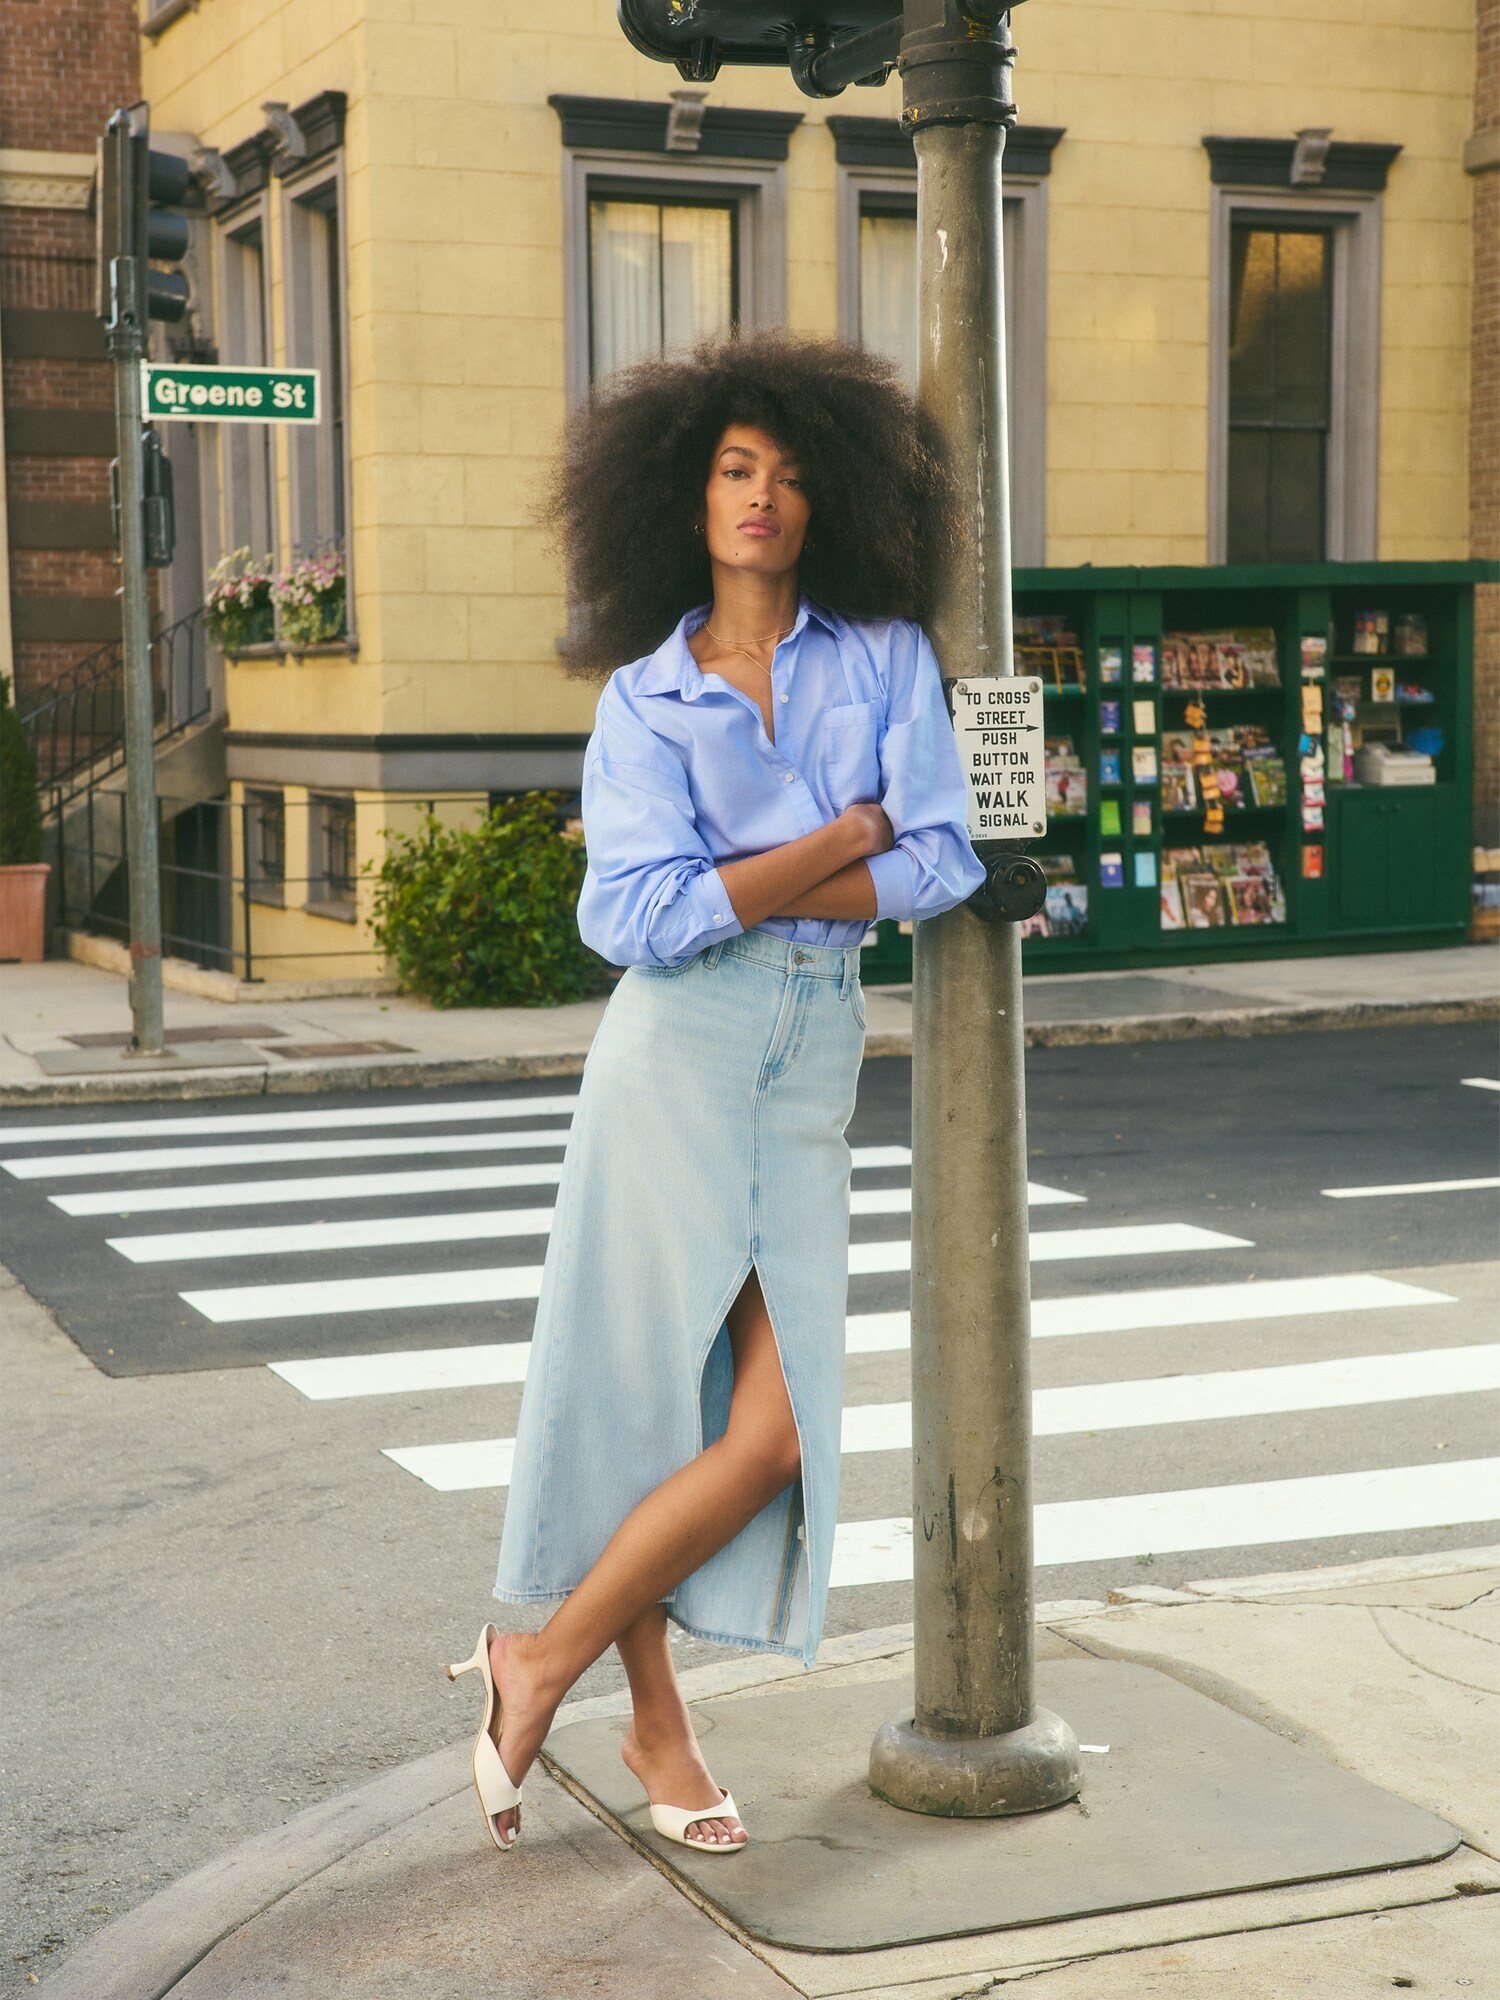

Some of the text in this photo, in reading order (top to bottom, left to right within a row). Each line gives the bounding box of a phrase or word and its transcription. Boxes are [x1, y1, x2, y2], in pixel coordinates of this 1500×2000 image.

[272, 381, 307, 409] St
[964, 691, 1031, 706] TO CROSS
[976, 710, 1026, 726] STREET
[982, 731, 1017, 746] PUSH
[972, 751, 1029, 767] BUTTON
[969, 771, 1035, 786] WAIT FOR
[975, 790, 1029, 809] WALK
[979, 812, 1029, 828] SIGNAL
